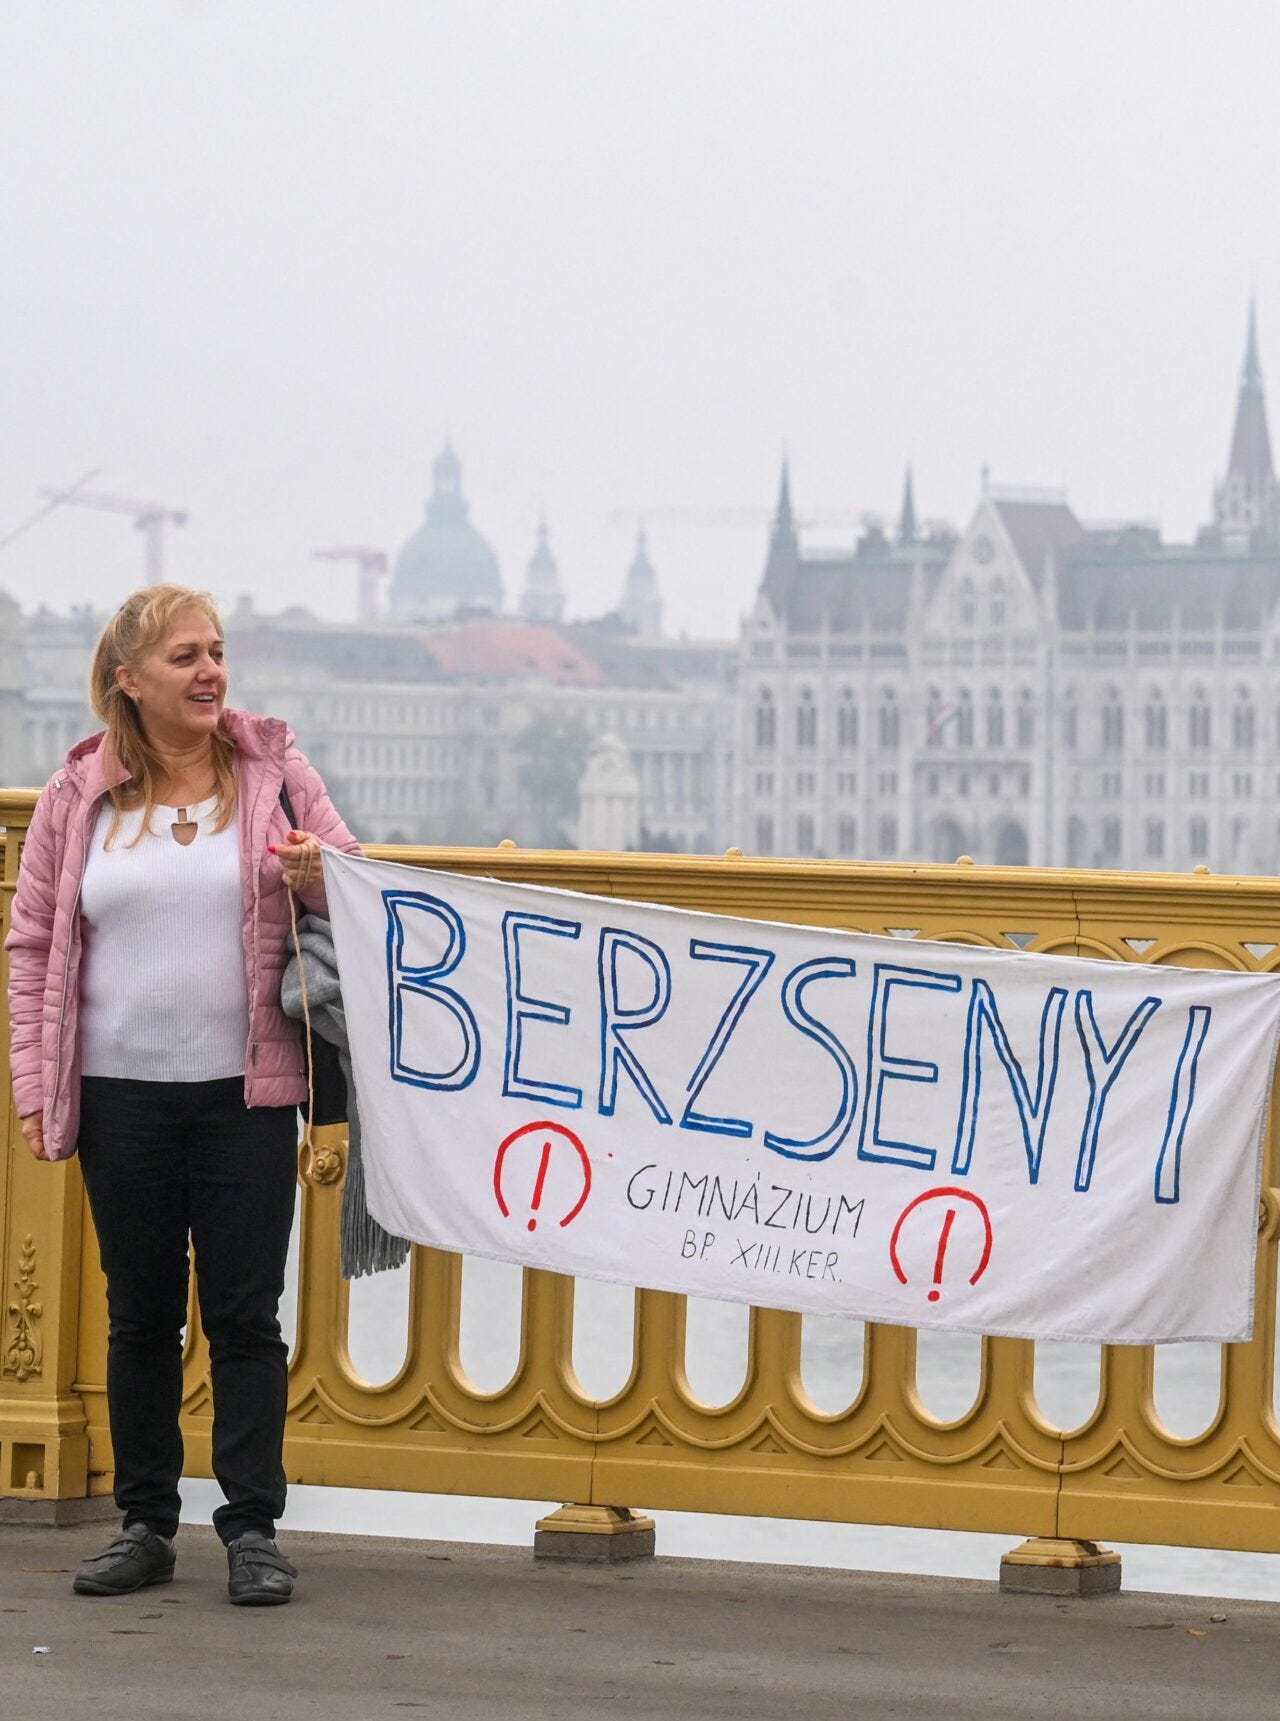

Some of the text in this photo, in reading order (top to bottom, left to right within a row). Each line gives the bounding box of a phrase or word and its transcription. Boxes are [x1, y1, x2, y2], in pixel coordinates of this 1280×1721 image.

[381, 889, 1212, 1204] BERZSENYI
[626, 1164, 865, 1238] GIMNÁZIUM
[680, 1229, 716, 1261] BP.
